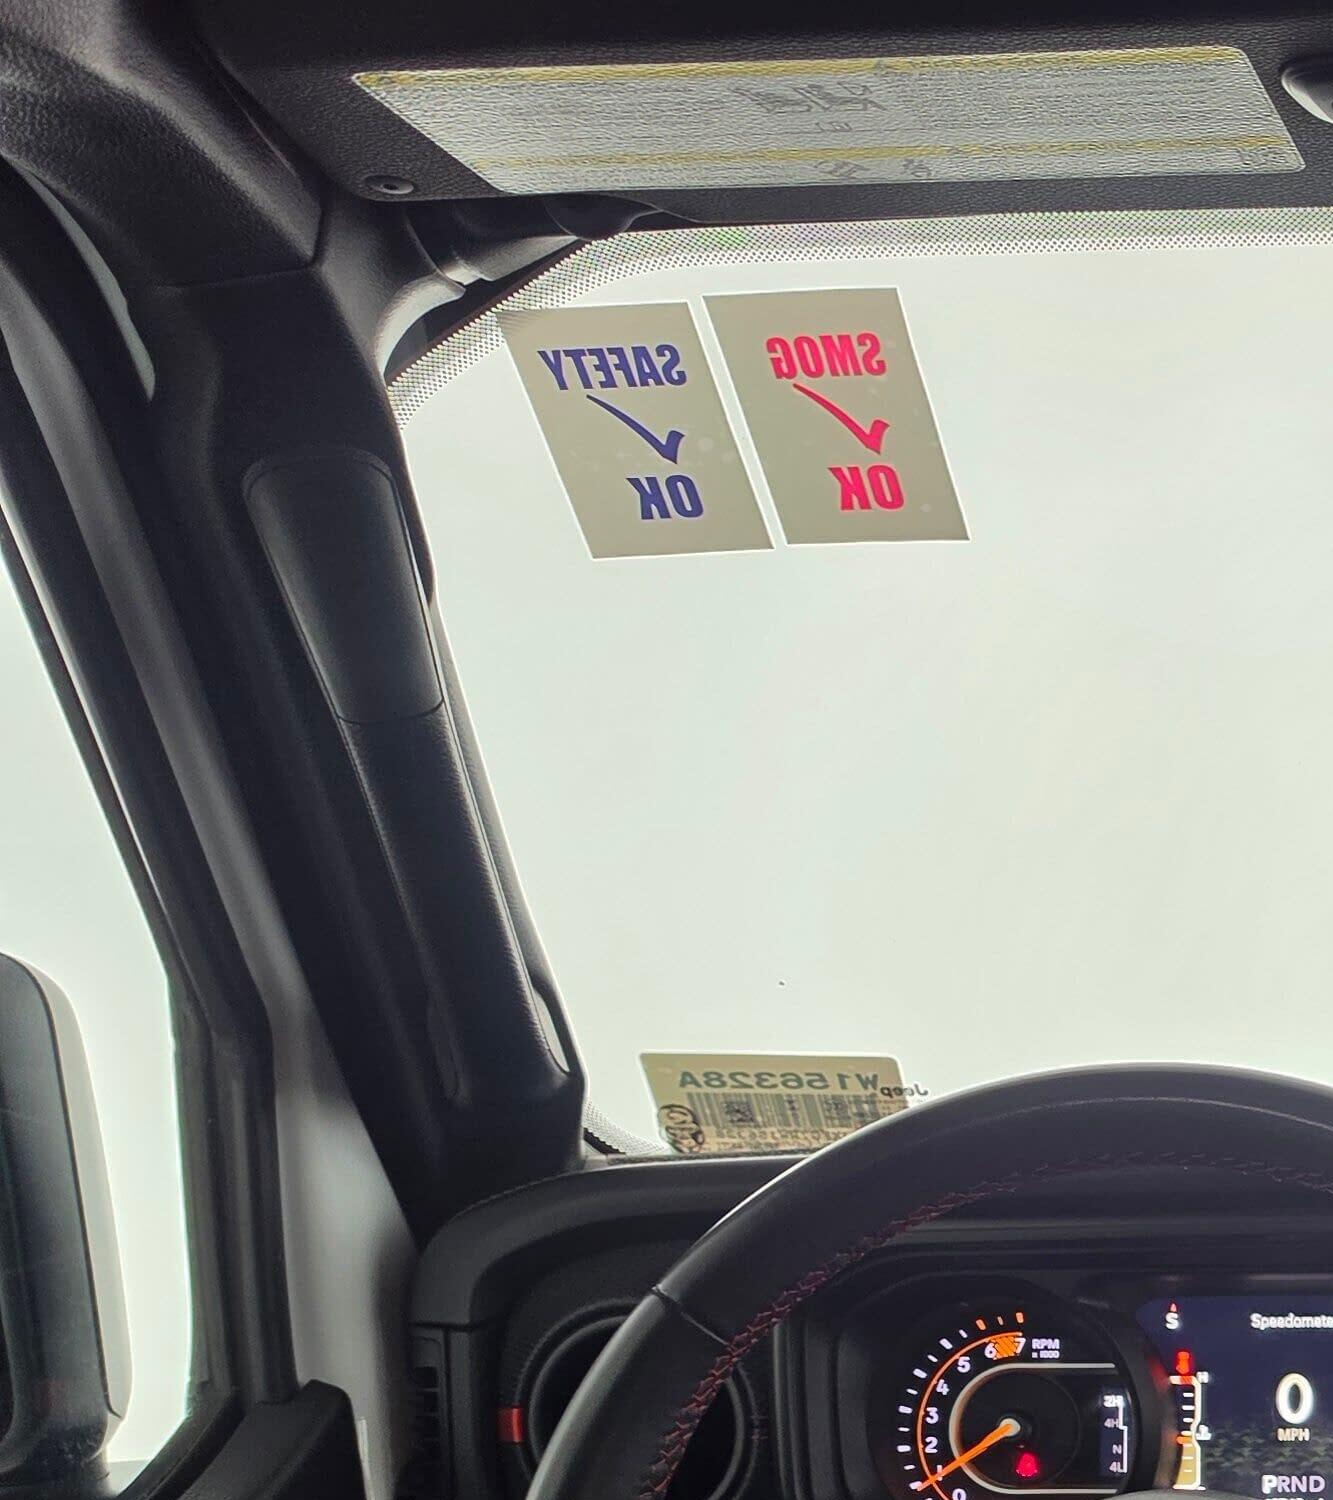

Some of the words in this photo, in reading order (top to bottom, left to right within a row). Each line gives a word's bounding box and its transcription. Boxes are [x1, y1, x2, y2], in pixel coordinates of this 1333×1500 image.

[1165, 1312, 1180, 1330] S
[984, 1343, 996, 1359] 6
[1015, 1337, 1026, 1354] 7
[1031, 1338, 1060, 1350] RPM
[957, 1356, 971, 1373] 5
[936, 1378, 950, 1395] 4
[1276, 1373, 1314, 1424] 0
[925, 1406, 939, 1424] 3
[1104, 1418, 1120, 1428] 4H
[1277, 1428, 1310, 1442] MPH
[925, 1436, 938, 1453] 2
[1112, 1444, 1122, 1454] N
